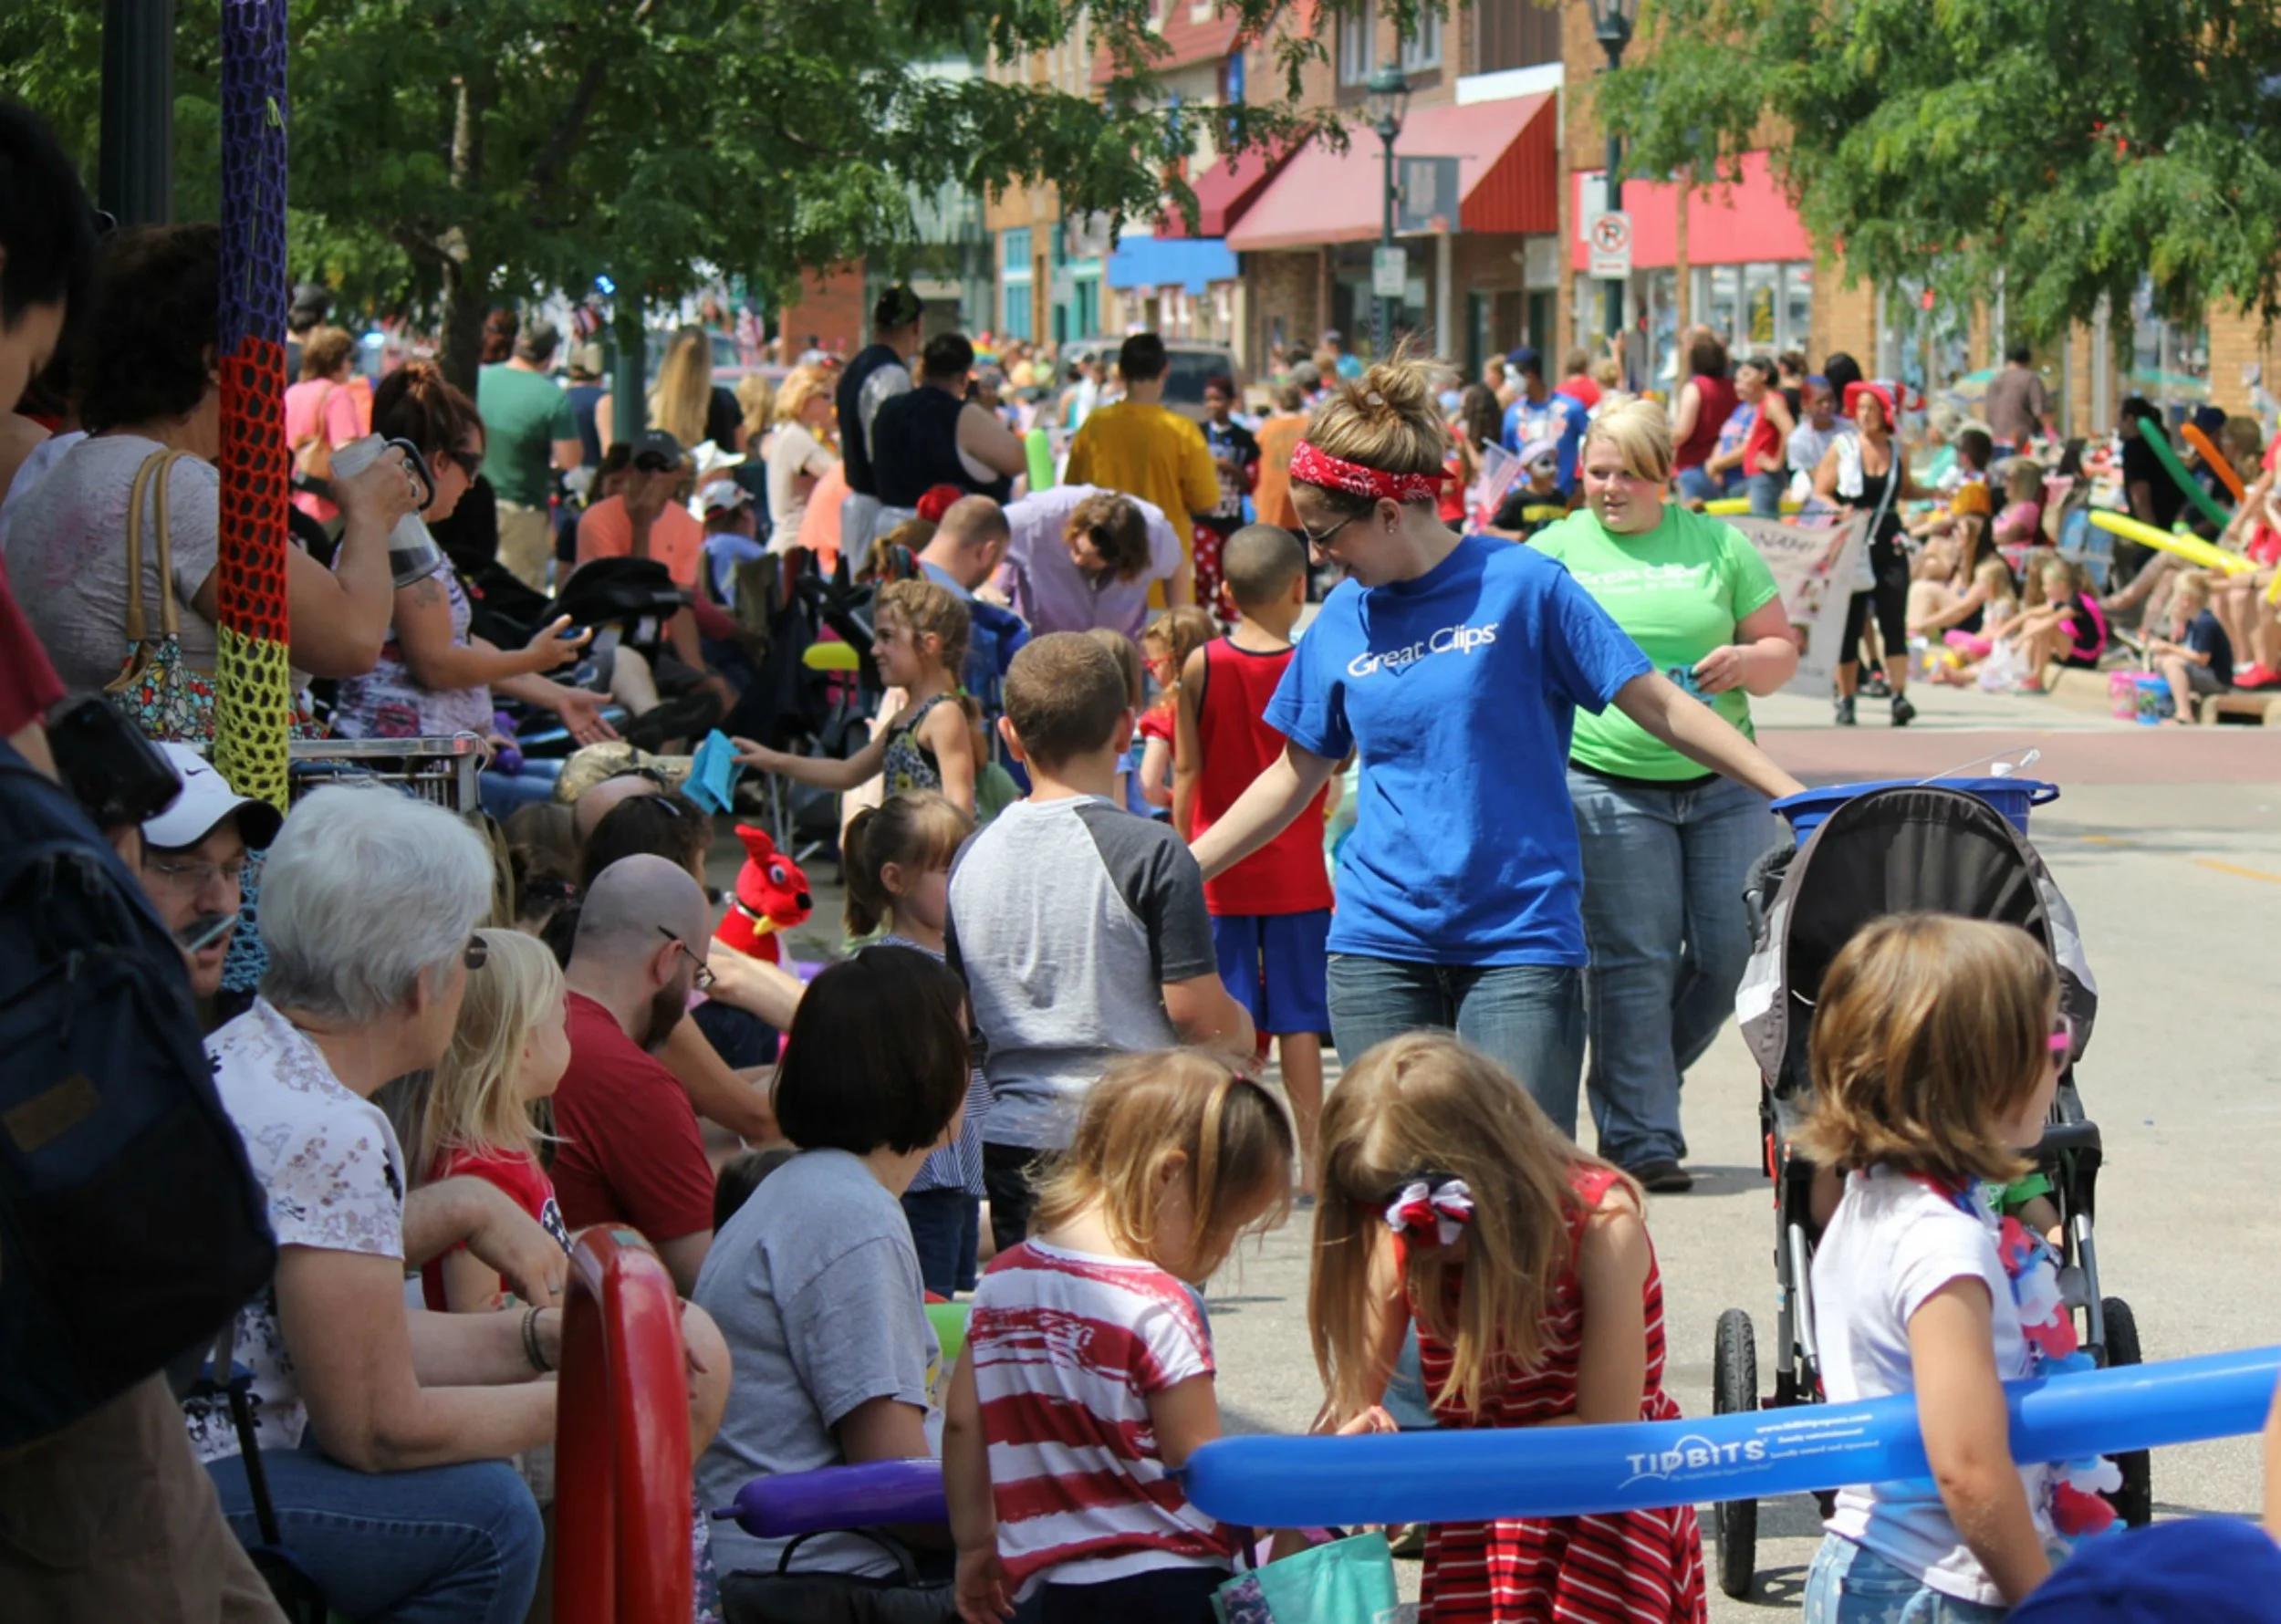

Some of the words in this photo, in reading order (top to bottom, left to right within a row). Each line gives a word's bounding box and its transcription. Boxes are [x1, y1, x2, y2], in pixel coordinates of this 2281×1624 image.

[1347, 640, 1424, 677] Great
[1428, 622, 1499, 654] Clips
[1626, 1439, 1766, 1474] TIDBITS
